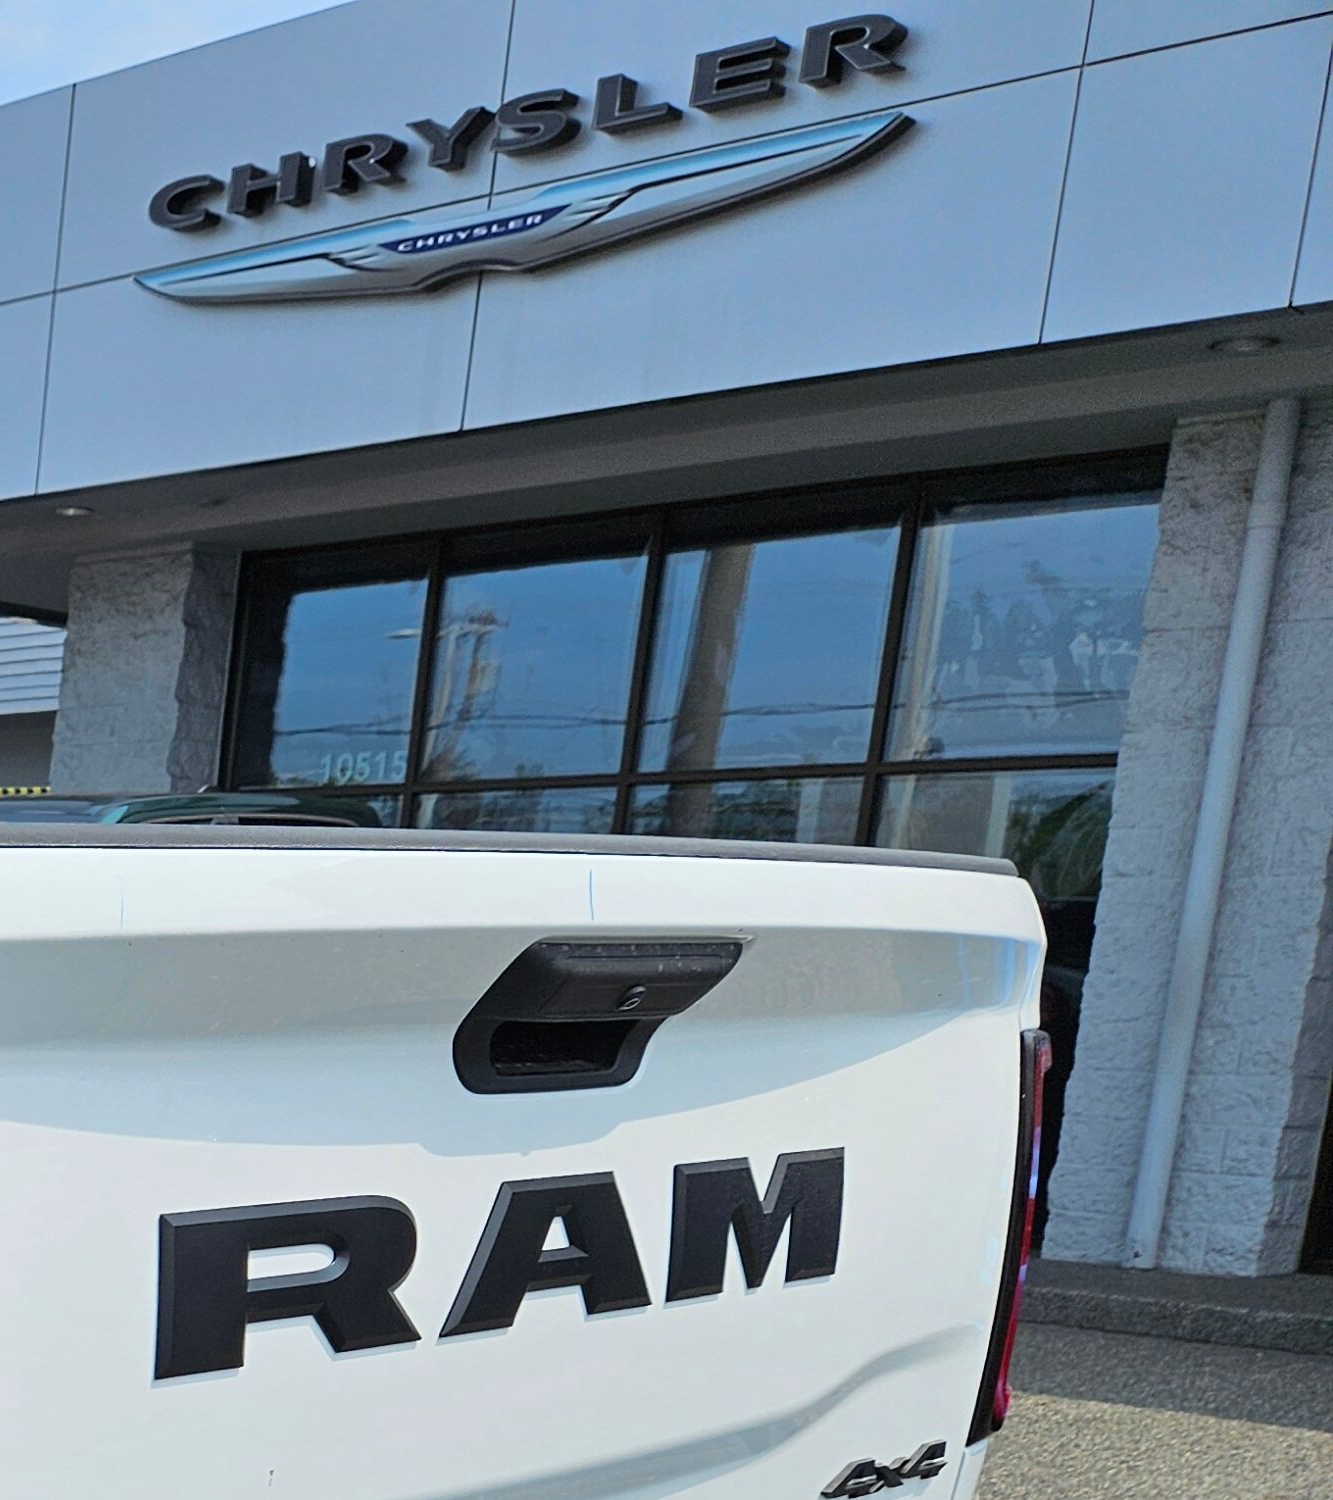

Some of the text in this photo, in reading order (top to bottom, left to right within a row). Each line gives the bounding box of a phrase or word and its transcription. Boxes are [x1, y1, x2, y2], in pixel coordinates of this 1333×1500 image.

[147, 13, 908, 232] CHRYSLER
[397, 213, 543, 252] CHRYSLER
[319, 751, 408, 786] 10515
[153, 1147, 846, 1381] RAM
[820, 1439, 948, 1500] 4x4
